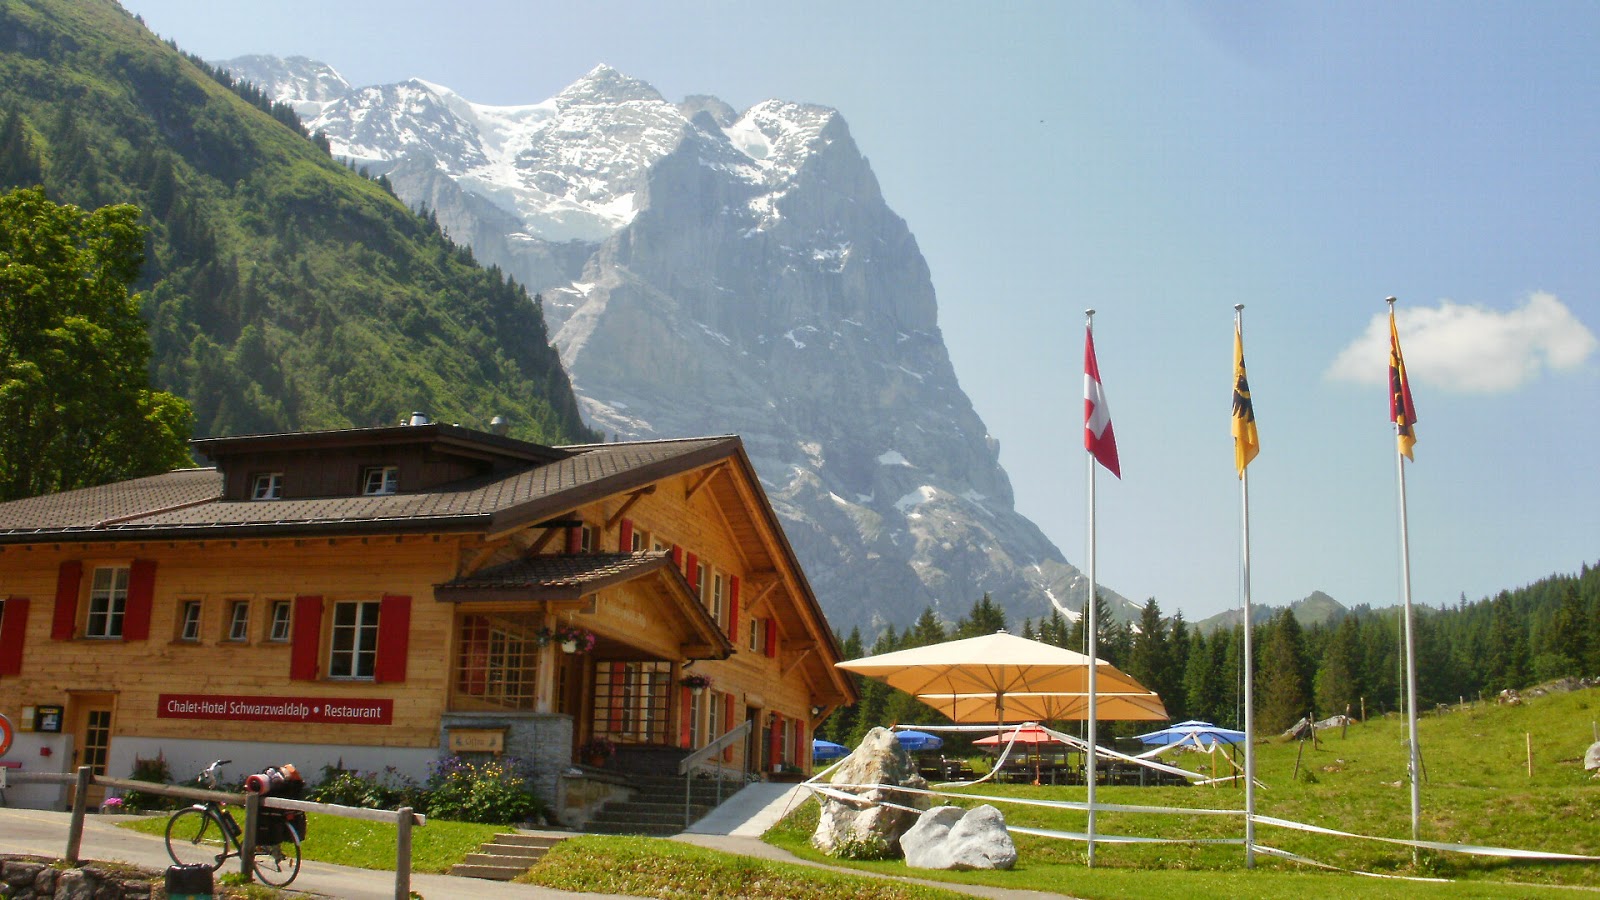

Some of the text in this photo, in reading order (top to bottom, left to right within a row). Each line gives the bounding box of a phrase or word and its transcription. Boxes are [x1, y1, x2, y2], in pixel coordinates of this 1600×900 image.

[167, 700, 381, 718] Chalet-Hotel Schwarzwaldalp Restaurant
